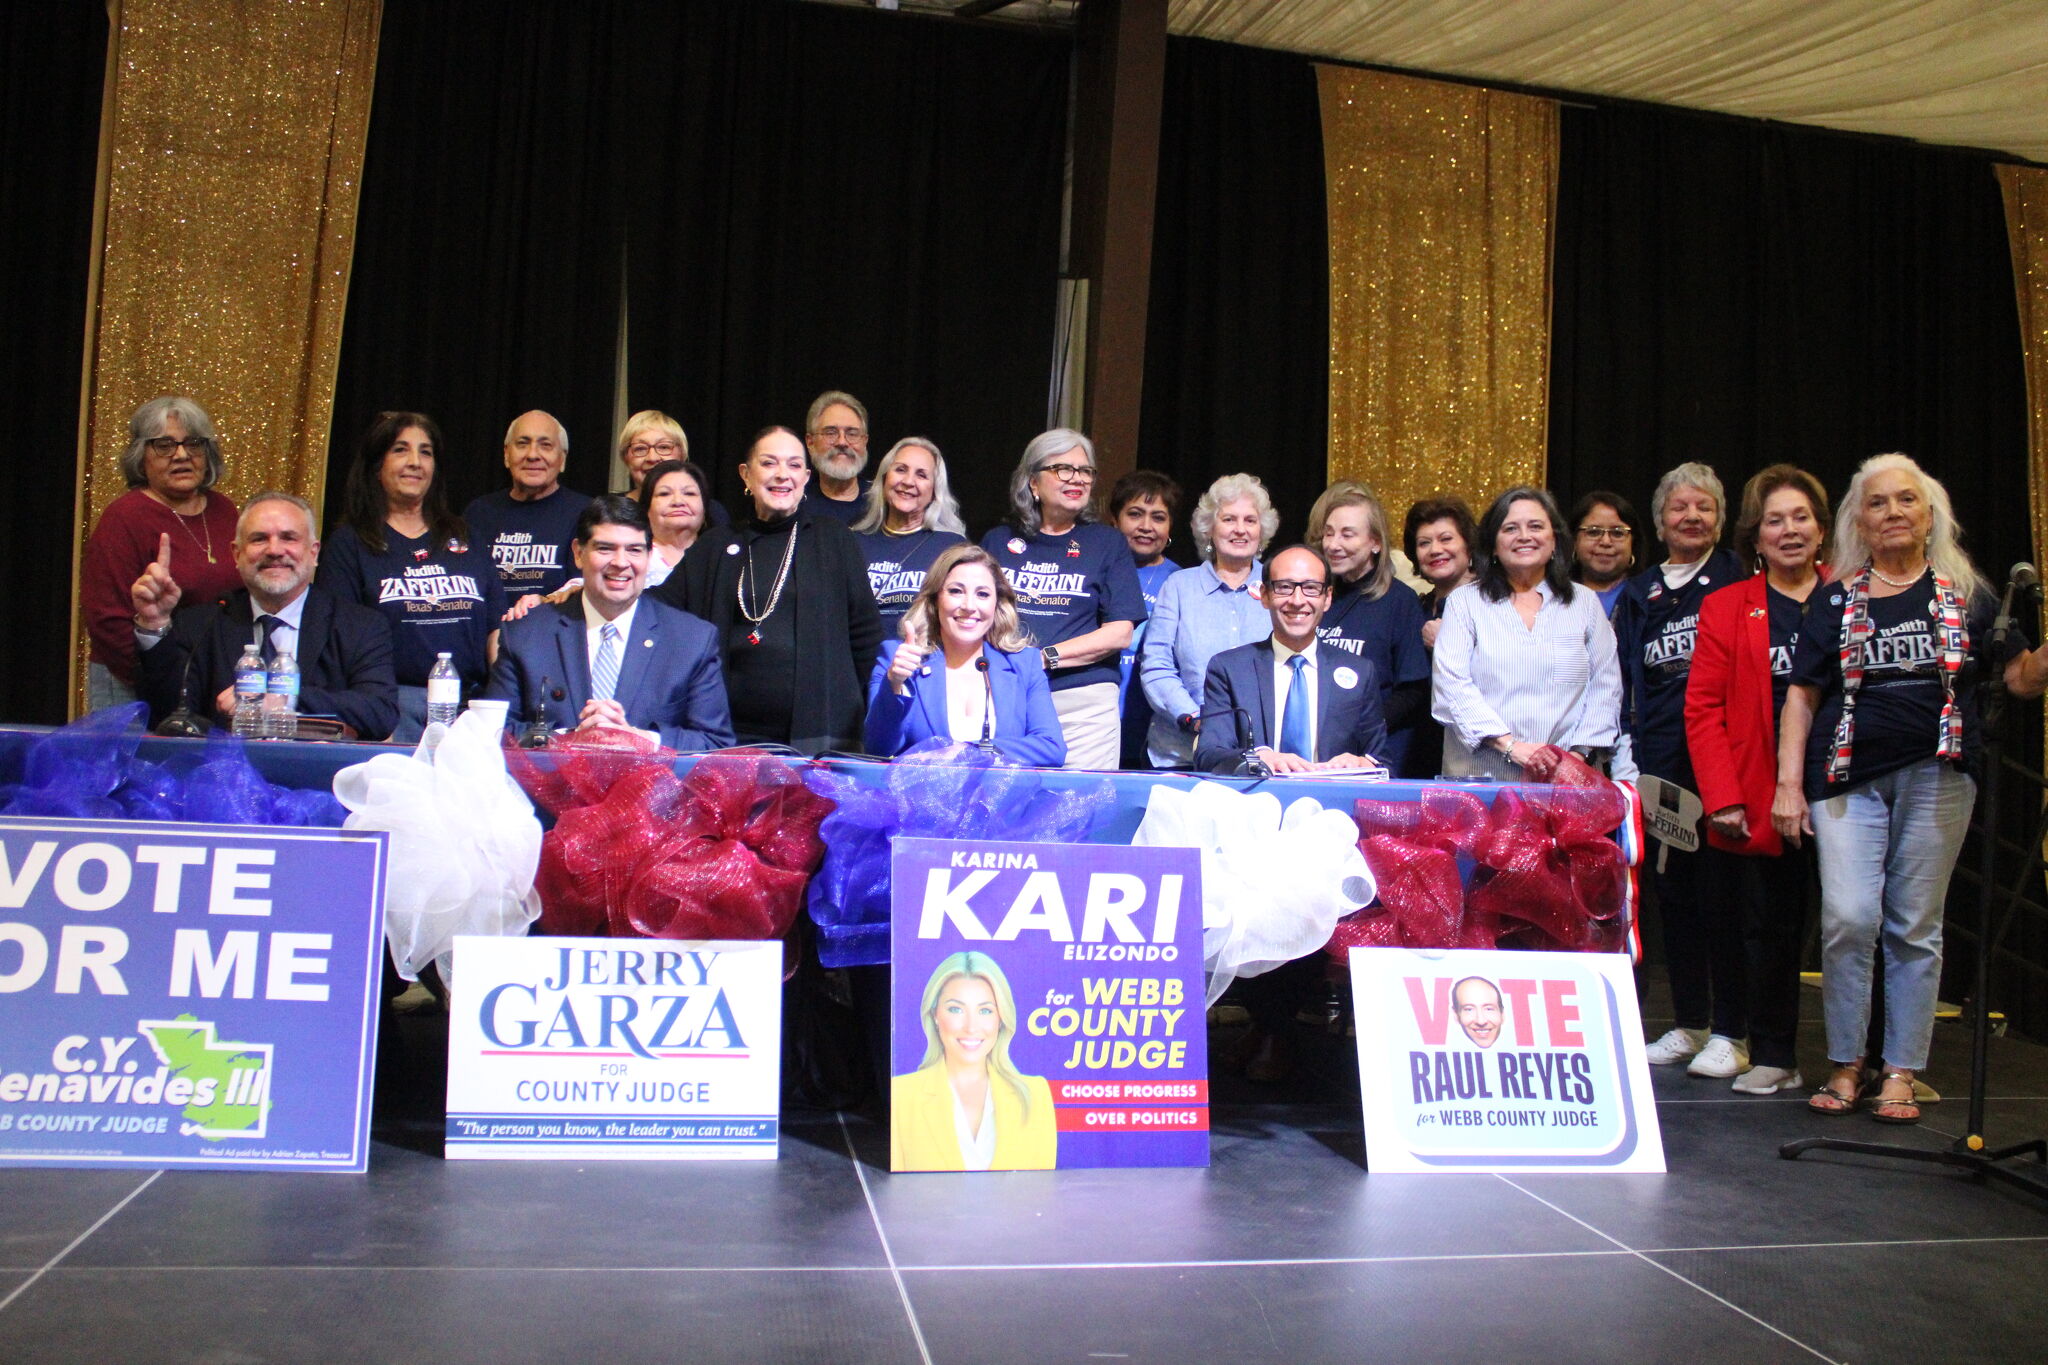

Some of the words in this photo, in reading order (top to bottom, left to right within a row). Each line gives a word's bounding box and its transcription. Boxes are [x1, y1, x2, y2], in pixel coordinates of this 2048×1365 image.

[496, 532, 532, 544] Judith
[492, 544, 558, 564] FFIRINI
[404, 564, 446, 577] Judith
[511, 569, 544, 580] Senator
[1021, 561, 1059, 574] Judith
[379, 575, 480, 598] ZAFFIRINI
[1000, 568, 1086, 592] AFFIRINI
[404, 600, 432, 612] Texas
[436, 600, 474, 612] Senator
[878, 593, 914, 604] Senator
[1016, 594, 1032, 604] xas
[1035, 594, 1071, 606] Senator
[1655, 816, 1696, 845] FFIRINI
[951, 851, 1038, 870] KARINA
[0, 840, 276, 917] VOTE
[918, 868, 1184, 944] KARI
[0, 922, 130, 996] OR
[169, 929, 334, 1002] ME
[1063, 945, 1178, 962] ELIZONDO
[544, 948, 720, 991] JERRY
[1046, 989, 1074, 1006] for
[1082, 978, 1184, 1006] WEBB
[478, 983, 750, 1060] GARZA
[1027, 1008, 1184, 1036] COUNTY
[52, 1035, 138, 1074] C.Y.
[1064, 1040, 1187, 1069] JUDGE
[600, 1063, 628, 1076] FOR
[1409, 1051, 1492, 1104] RAUL
[1498, 1052, 1595, 1105] REYES
[0, 1066, 219, 1106] enavides
[516, 1080, 620, 1102] COUNTY
[626, 1082, 710, 1103] JUDGE
[1061, 1085, 1120, 1098] CHOOSE
[1124, 1085, 1197, 1098] PROGRESS
[17, 1114, 102, 1132] COUNTY
[101, 1116, 169, 1134] JUDGE
[1084, 1112, 1126, 1125] OVER
[1131, 1112, 1198, 1124] POLITICS
[1416, 1112, 1436, 1127] for
[1439, 1110, 1483, 1126] WEBB
[1487, 1110, 1546, 1126] COUNTY
[1551, 1111, 1598, 1127] JUDGE
[490, 1124, 534, 1138] person
[536, 1124, 560, 1138] you
[564, 1122, 601, 1138] know,
[605, 1122, 626, 1136] the
[628, 1122, 670, 1136] leader
[672, 1126, 695, 1138] you
[697, 1126, 720, 1136] can
